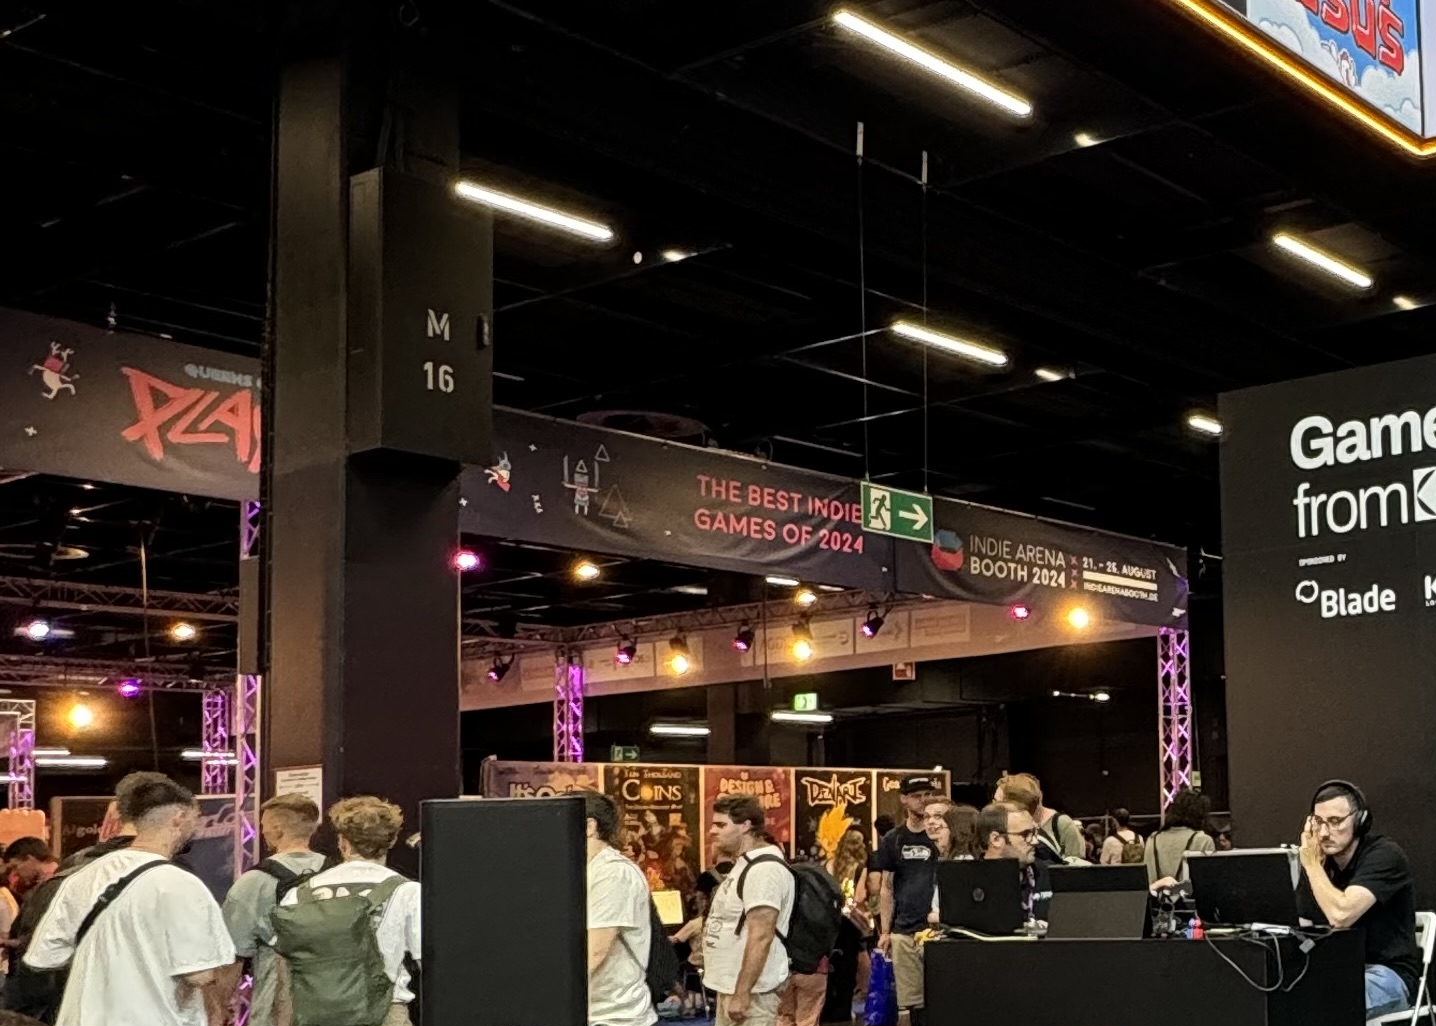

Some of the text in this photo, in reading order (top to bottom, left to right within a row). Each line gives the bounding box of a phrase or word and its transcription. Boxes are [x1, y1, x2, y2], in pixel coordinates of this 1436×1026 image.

[427, 308, 450, 341] M
[423, 361, 454, 393] 16
[696, 474, 862, 524] THE BEST INDIE
[1292, 482, 1409, 538] from
[694, 508, 864, 554] GAMES OF 2024
[970, 535, 1066, 569] INDIE ARENA
[970, 556, 1066, 589] BOOTH 2024
[1121, 564, 1157, 580] AUGUST
[1320, 584, 1396, 618] Blade
